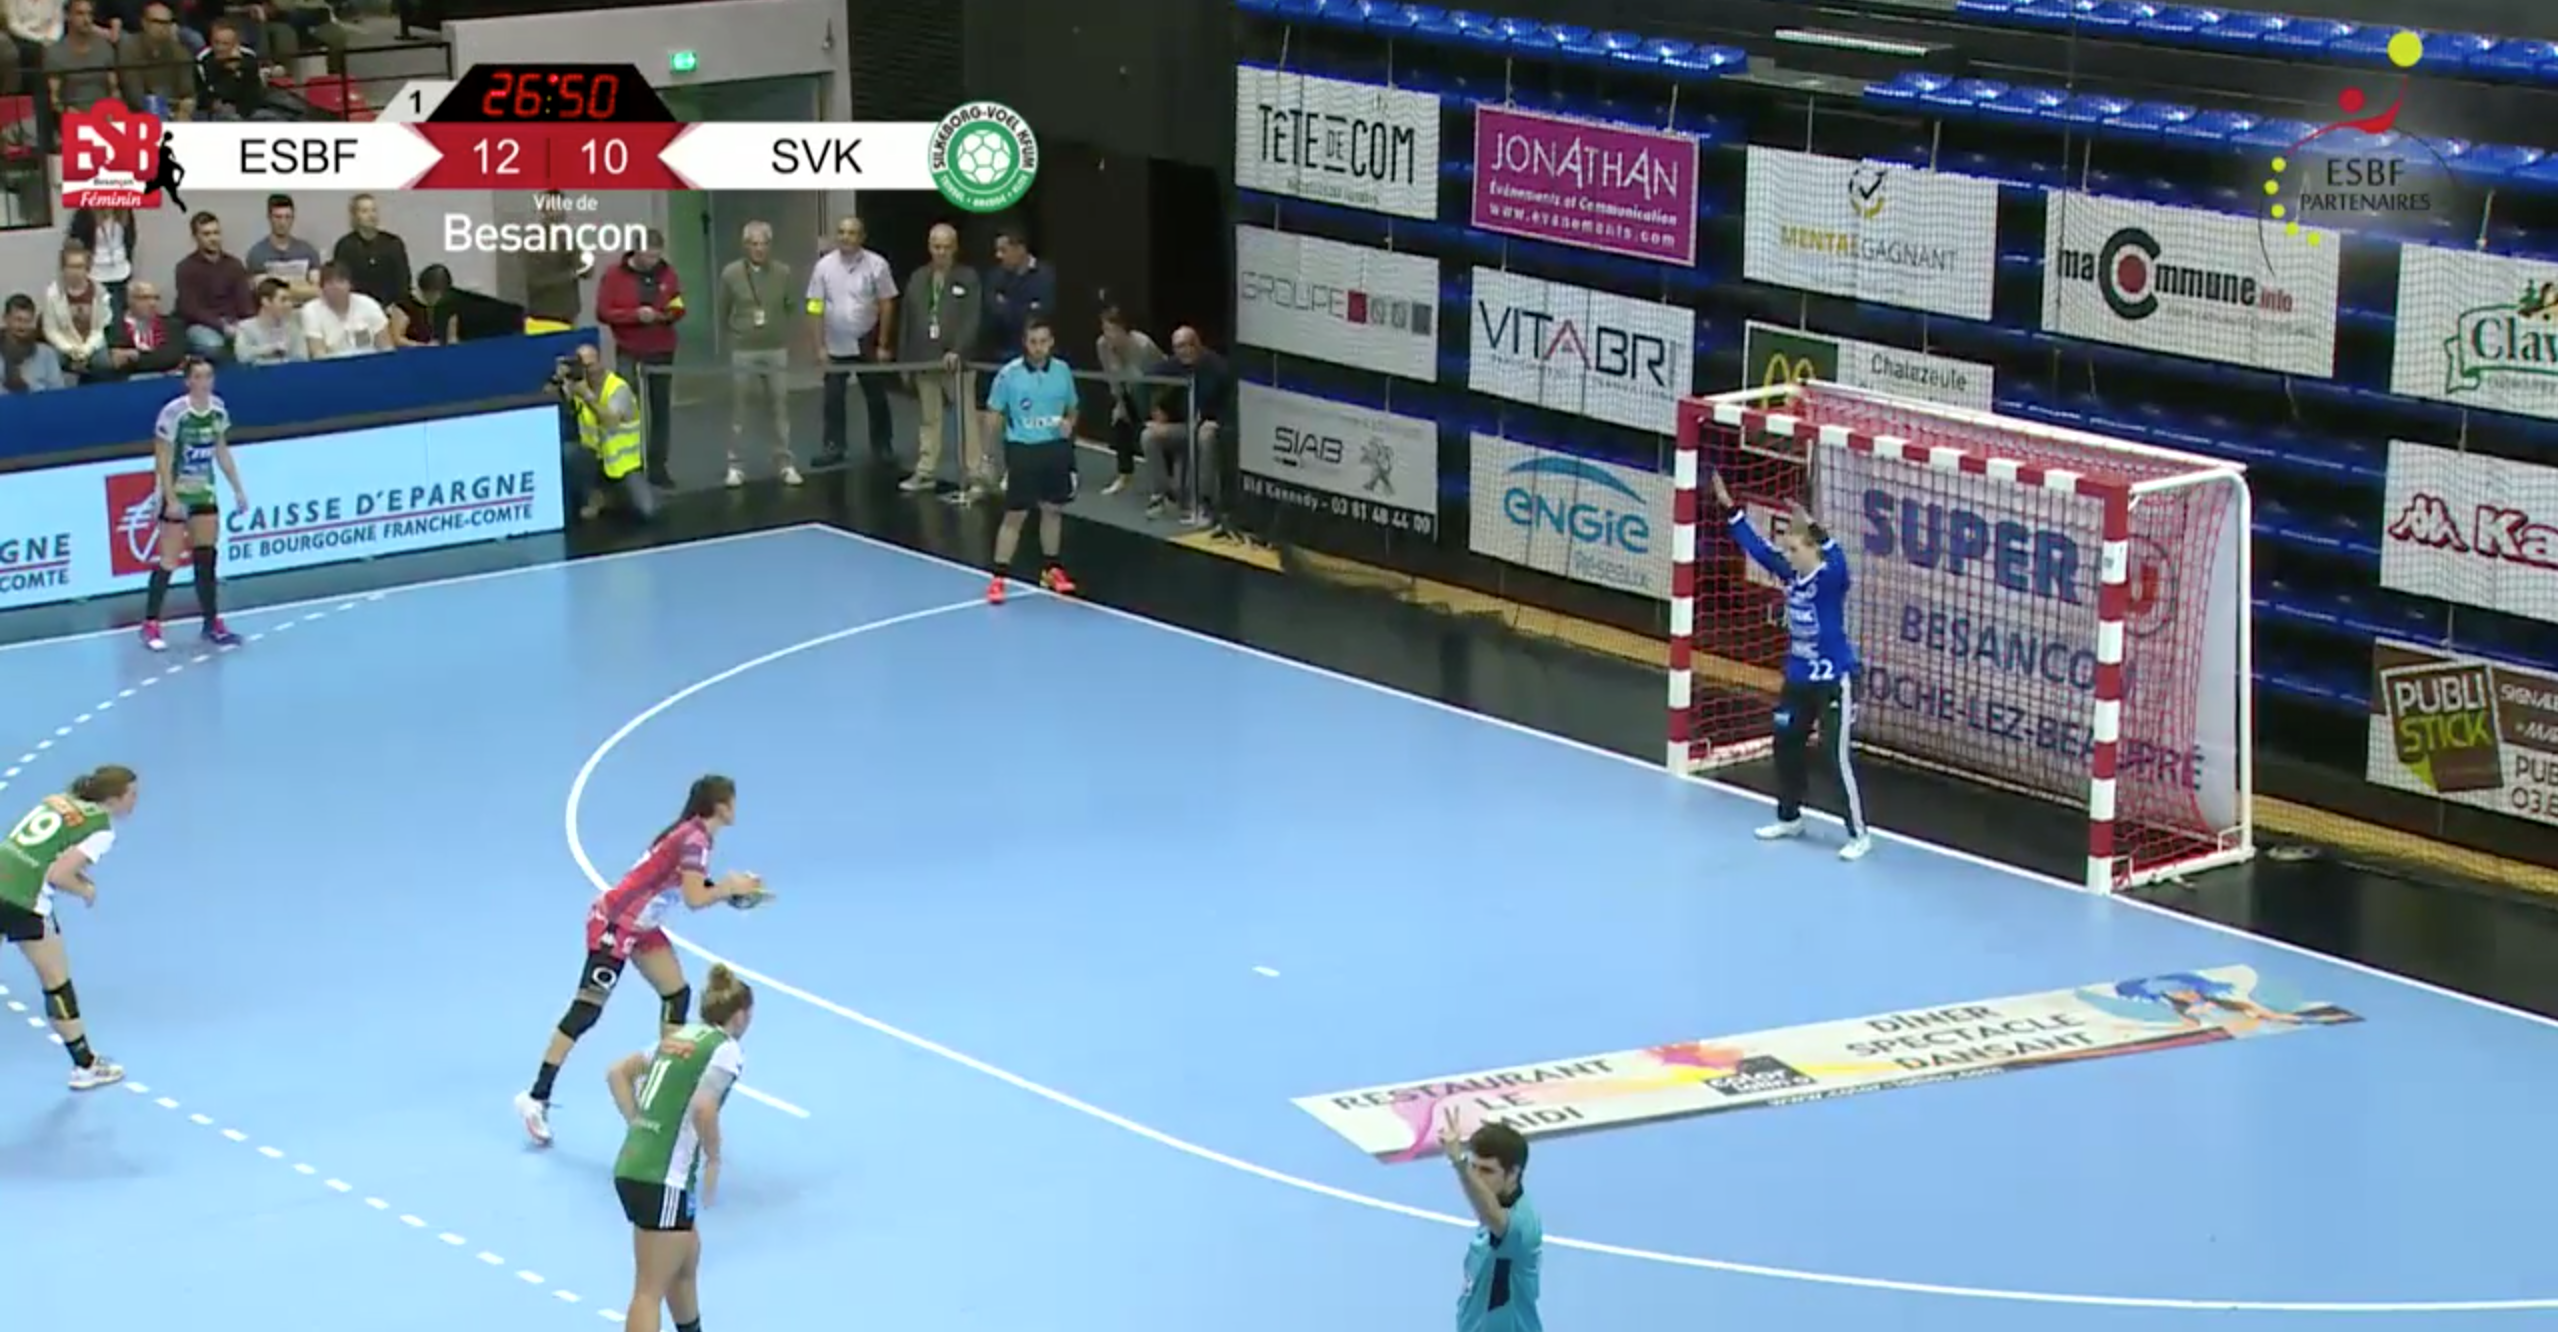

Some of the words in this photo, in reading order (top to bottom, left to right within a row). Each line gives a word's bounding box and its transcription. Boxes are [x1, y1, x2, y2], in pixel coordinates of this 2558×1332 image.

[1258, 103, 1320, 169] TÊTE
[1327, 129, 1344, 161] DE
[1351, 118, 1415, 185] COM
[1490, 132, 1679, 201] JONATHAN
[1578, 195, 1678, 227] Communication
[1272, 426, 1344, 465] SIAB
[226, 497, 342, 533] CAISSE
[228, 544, 252, 562] DE
[259, 526, 377, 558] BOURGOGNE
[1863, 488, 2082, 606] SUPER
[1808, 658, 1835, 681] 22
[2394, 672, 2487, 717] PUBLI
[2400, 710, 2493, 754] STICK
[9, 804, 63, 847] 19
[1846, 1012, 2087, 1058] SPECTACLE
[1893, 1030, 2096, 1071] DANSANT
[1330, 1057, 1616, 1111] RESTAURANT
[1473, 1090, 1537, 1111] LE
